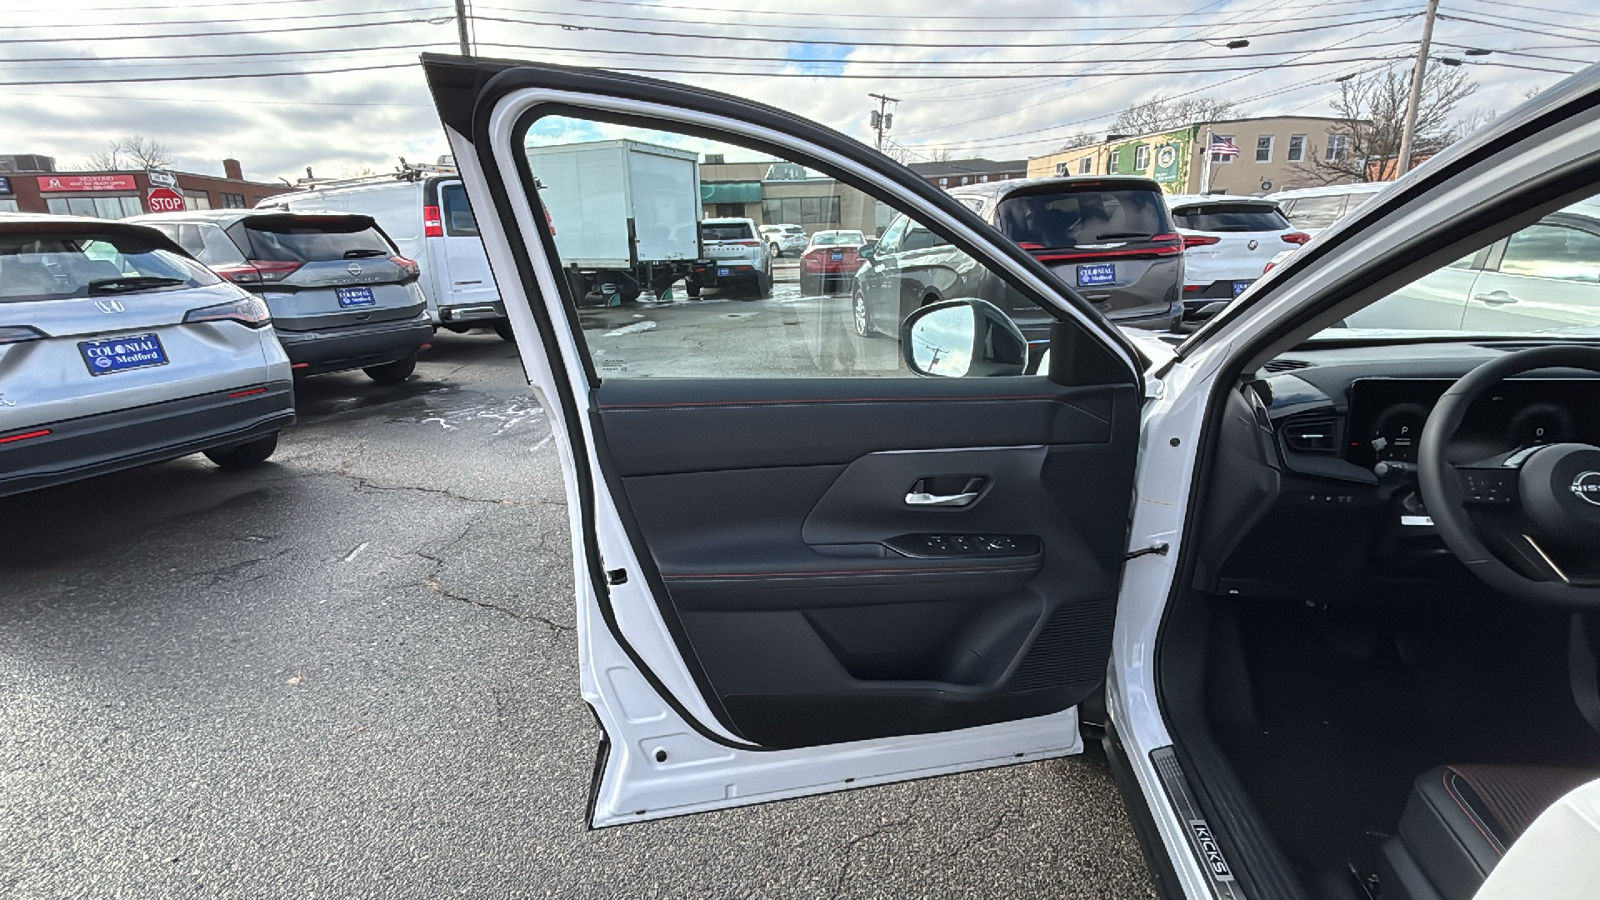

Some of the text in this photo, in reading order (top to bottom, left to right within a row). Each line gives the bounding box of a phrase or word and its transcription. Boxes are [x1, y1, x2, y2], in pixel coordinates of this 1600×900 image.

[151, 197, 181, 211] STOP
[1080, 268, 1114, 276] COLONIAL
[87, 341, 158, 358] COLONIAL
[115, 351, 159, 364] Medford
[1401, 426, 1409, 435] P
[1195, 827, 1227, 873] KICKS
